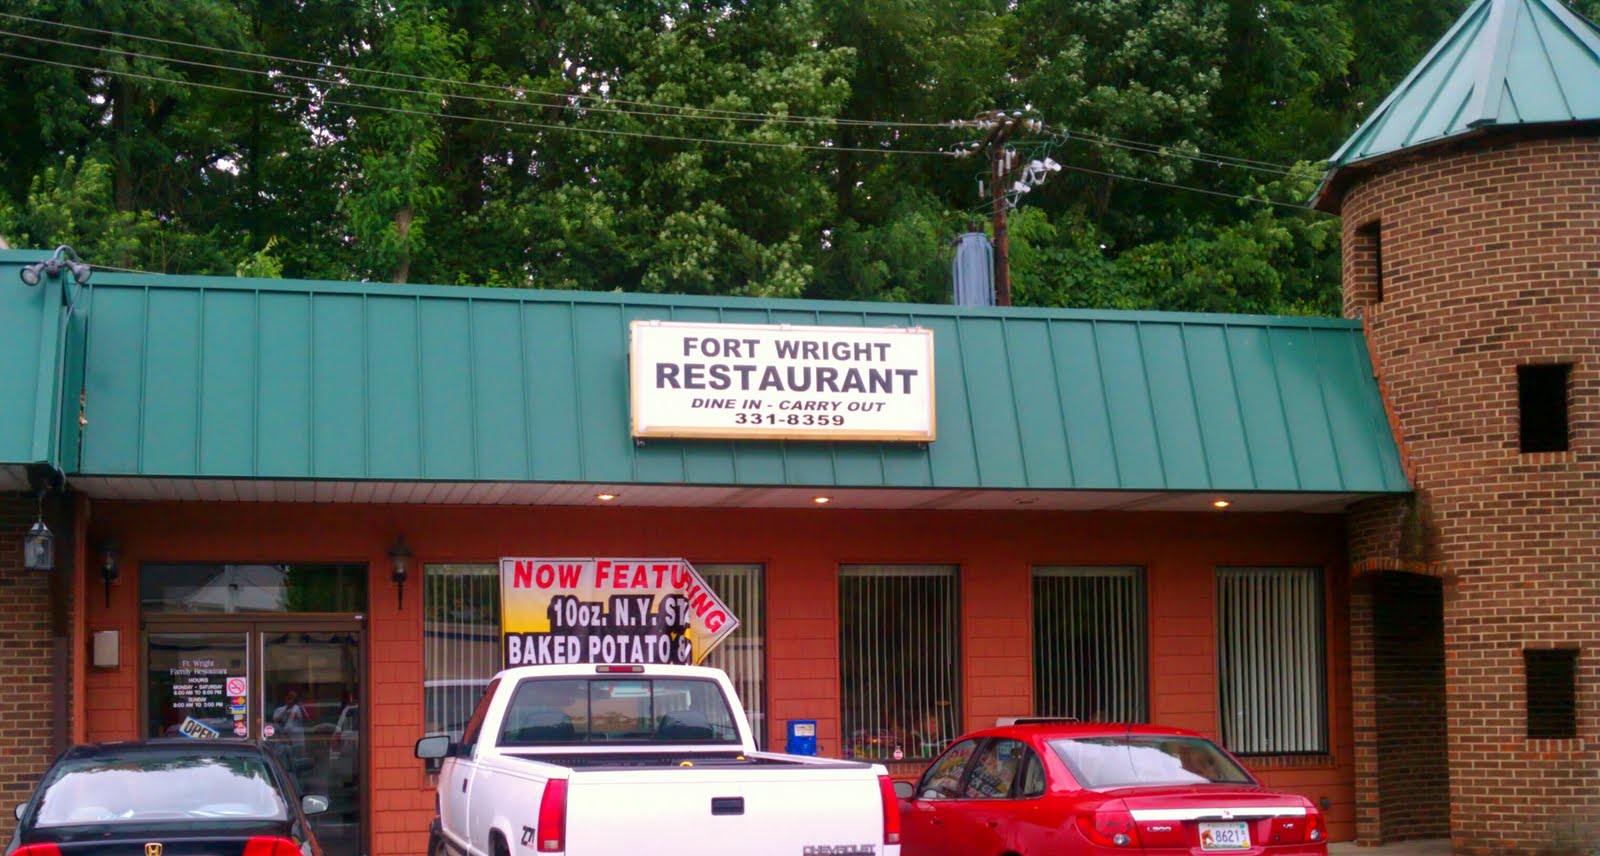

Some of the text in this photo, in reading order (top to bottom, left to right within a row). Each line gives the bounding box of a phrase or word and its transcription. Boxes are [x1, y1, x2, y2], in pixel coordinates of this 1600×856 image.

[683, 337, 891, 362] FORT WRIGHT
[655, 362, 918, 395] RESTAURANT
[691, 398, 736, 409] DINE
[742, 399, 762, 410] IN
[779, 400, 841, 412] CARRY
[847, 401, 886, 413] OUT
[734, 413, 846, 426] 331-8359
[513, 560, 583, 589] NOW
[553, 598, 607, 627] 10oz.
[615, 598, 657, 627] N.Y.
[508, 635, 581, 665] BAKED
[588, 634, 671, 665] POTATO
[193, 659, 214, 668] Wright
[170, 668, 190, 676] Family
[1215, 830, 1240, 843] 8621
[803, 844, 876, 854] CHEVROLET
